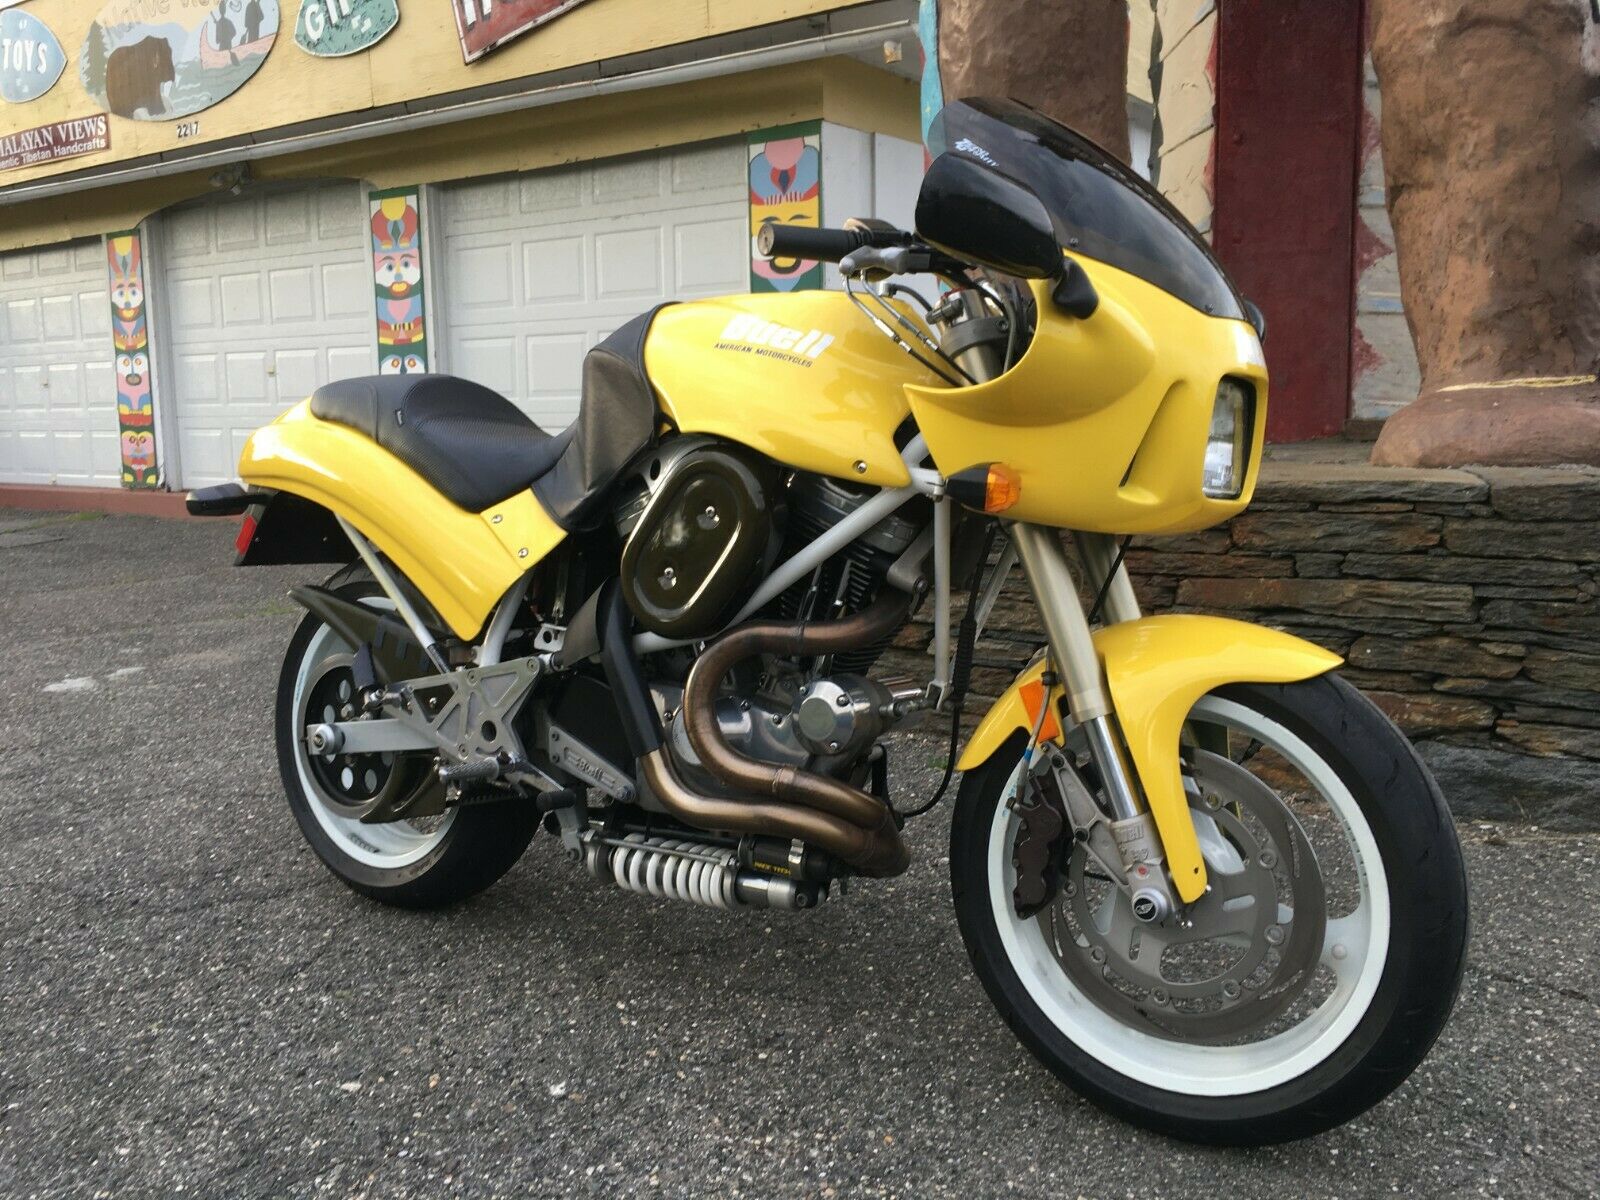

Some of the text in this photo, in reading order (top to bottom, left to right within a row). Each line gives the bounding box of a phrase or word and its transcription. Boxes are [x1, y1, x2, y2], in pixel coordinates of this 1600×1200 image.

[2, 38, 48, 74] TOYS
[58, 116, 106, 143] VIEWS
[22, 149, 51, 164] Tibetan
[54, 138, 106, 157] Handcrafts
[720, 313, 836, 359] Buell
[713, 342, 813, 369] AMERICAN MOTORCYCLES
